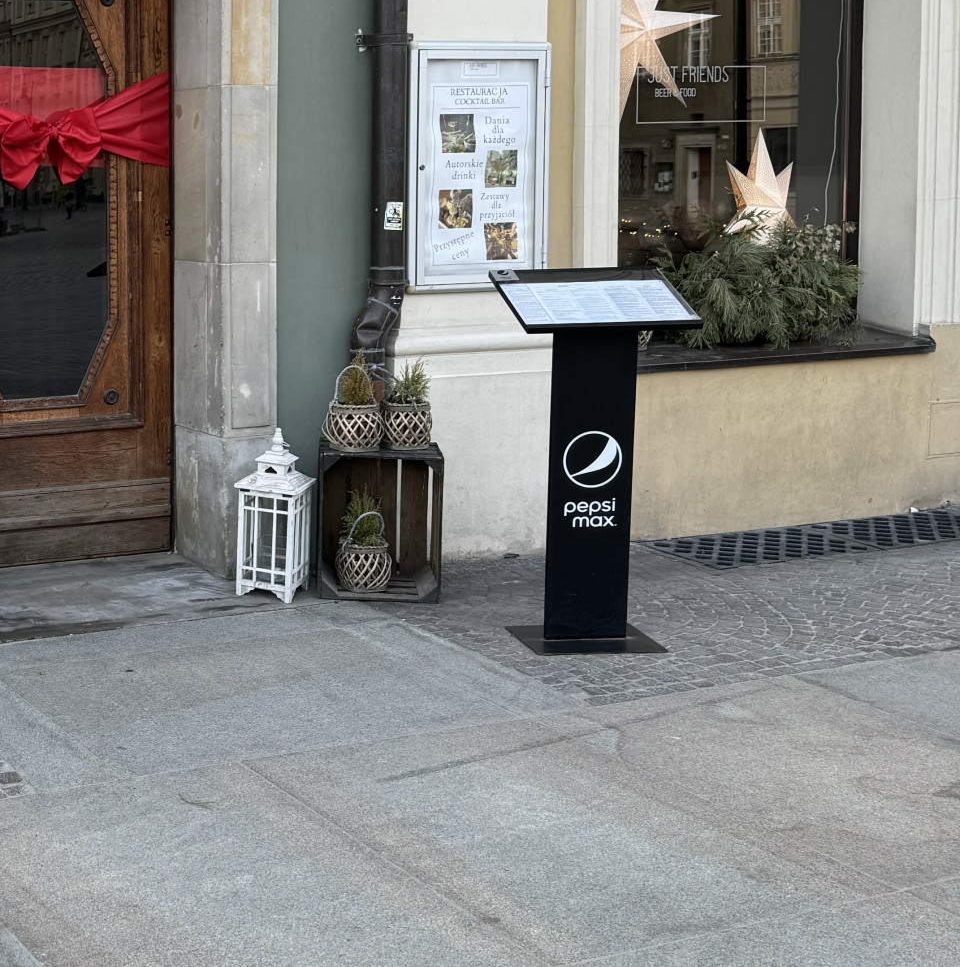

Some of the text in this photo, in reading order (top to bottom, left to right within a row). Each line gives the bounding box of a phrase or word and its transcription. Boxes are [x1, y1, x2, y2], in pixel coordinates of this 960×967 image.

[681, 65, 729, 83] FRIENDS
[654, 88, 672, 97] BEER
[680, 88, 696, 97] FOOD
[492, 97, 505, 105] BAR
[485, 115, 510, 125] Dania
[492, 125, 504, 134] dla
[483, 134, 516, 146] każdego
[445, 158, 484, 168] Autorskie
[452, 170, 476, 180] drinki
[480, 192, 510, 202] Zestawy
[491, 201, 502, 209] dla
[479, 209, 515, 221] przyjaciół
[433, 231, 475, 252] Przystępne
[451, 248, 470, 260] ceny
[563, 497, 616, 517] pepsi
